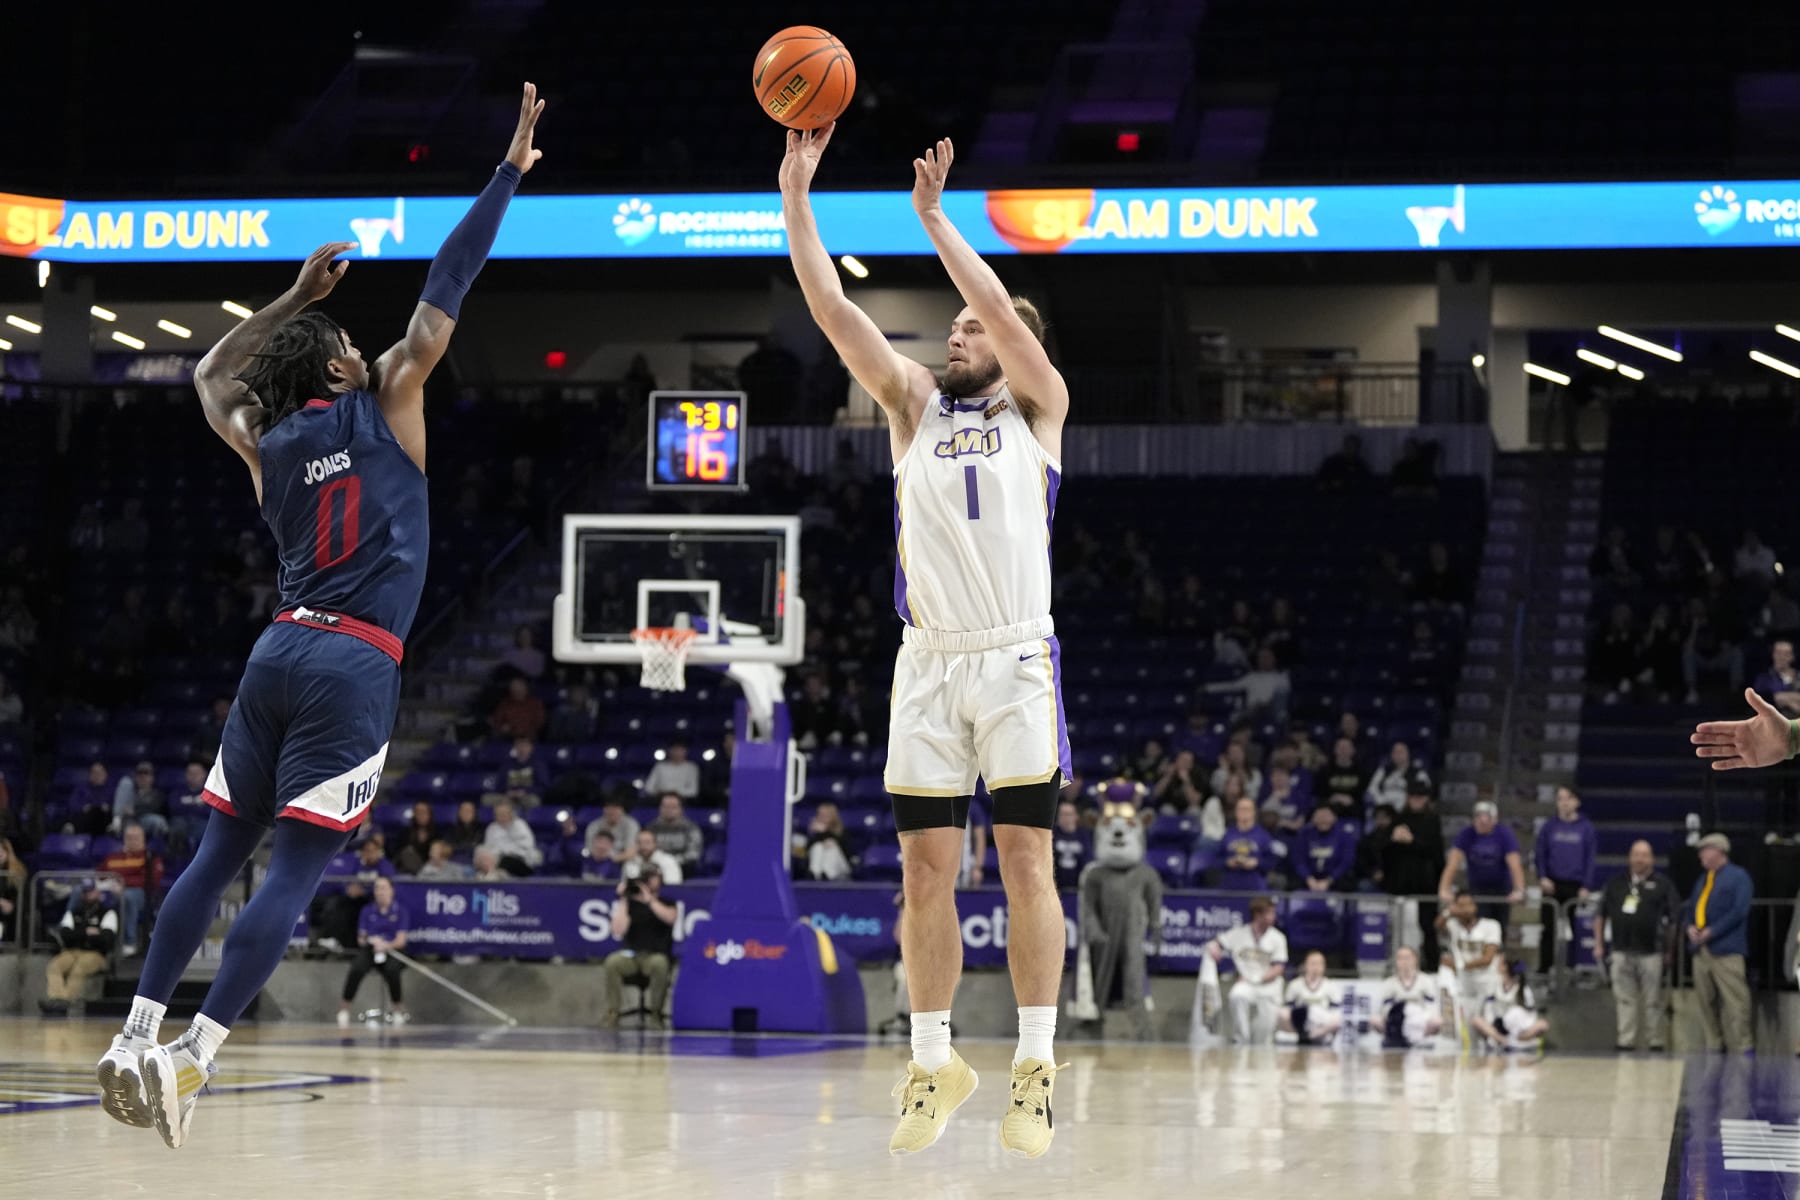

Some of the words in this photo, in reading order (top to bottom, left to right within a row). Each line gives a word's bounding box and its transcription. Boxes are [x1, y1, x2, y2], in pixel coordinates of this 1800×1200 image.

[6, 206, 134, 249] SLAM
[142, 209, 271, 249] DUNK
[659, 210, 786, 234] ROCKINGHA
[1031, 199, 1169, 241] SLAM
[1179, 197, 1318, 238] DUNK
[679, 402, 738, 431] 7:31
[685, 432, 728, 480] 16
[934, 426, 1002, 459] JMU
[964, 465, 980, 520] 1
[425, 888, 467, 916] the
[471, 888, 520, 925] hills
[1159, 905, 1190, 928] he
[811, 912, 881, 937] Dukes
